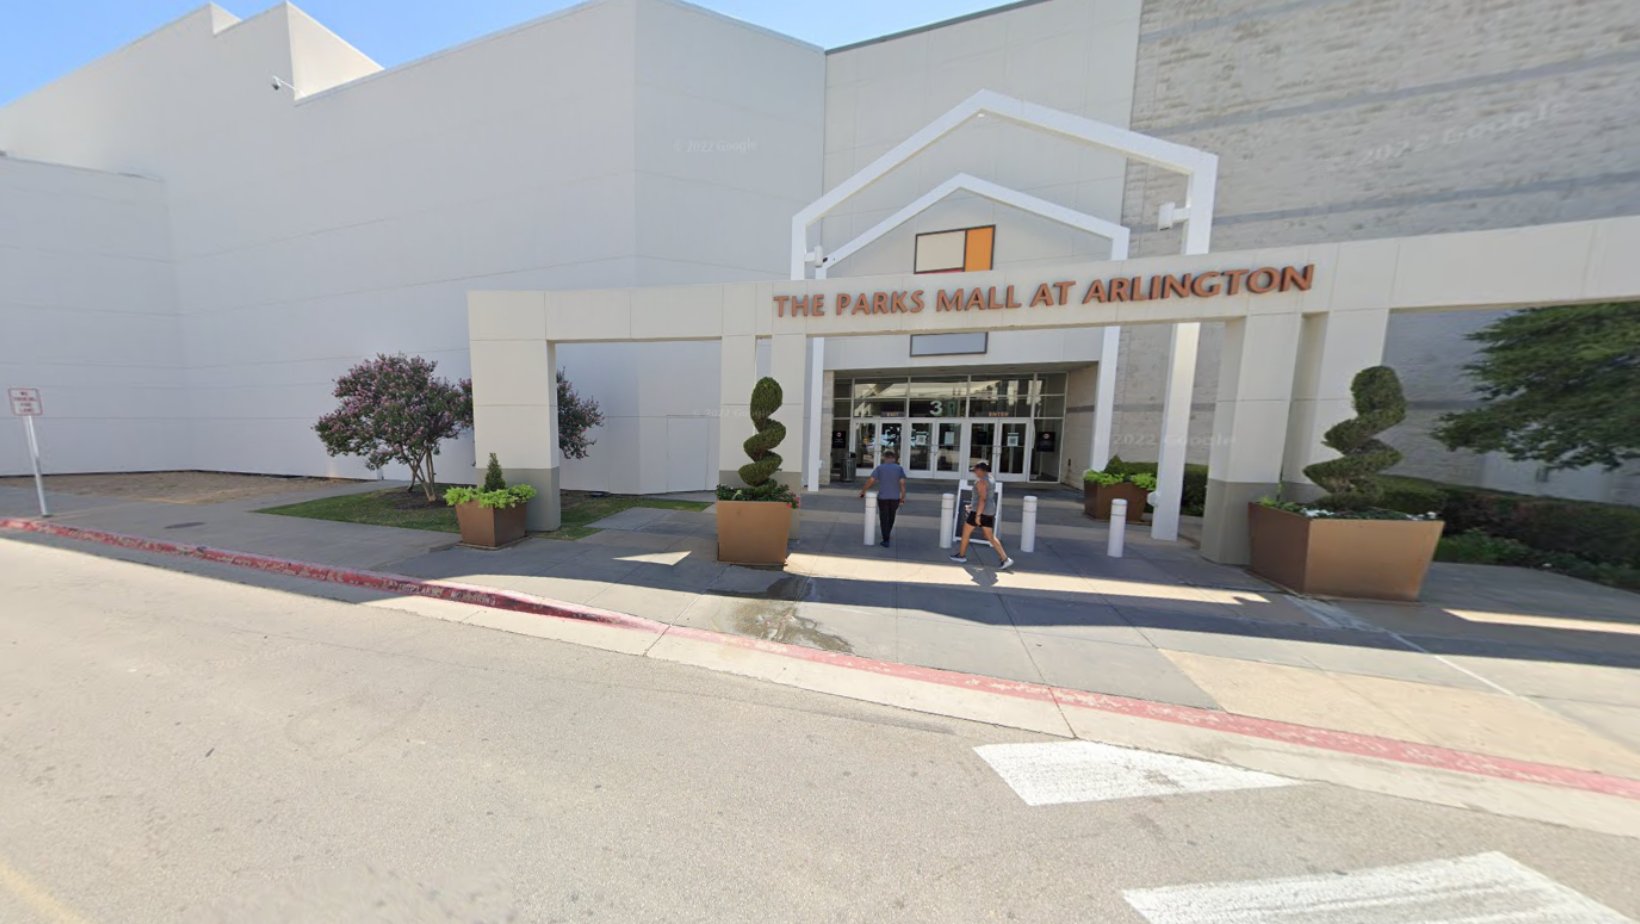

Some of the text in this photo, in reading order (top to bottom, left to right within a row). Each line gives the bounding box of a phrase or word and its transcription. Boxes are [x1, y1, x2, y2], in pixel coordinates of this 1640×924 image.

[773, 264, 1315, 317] THE PARKS MALL AT ARLINGTON
[929, 400, 943, 416] 3
